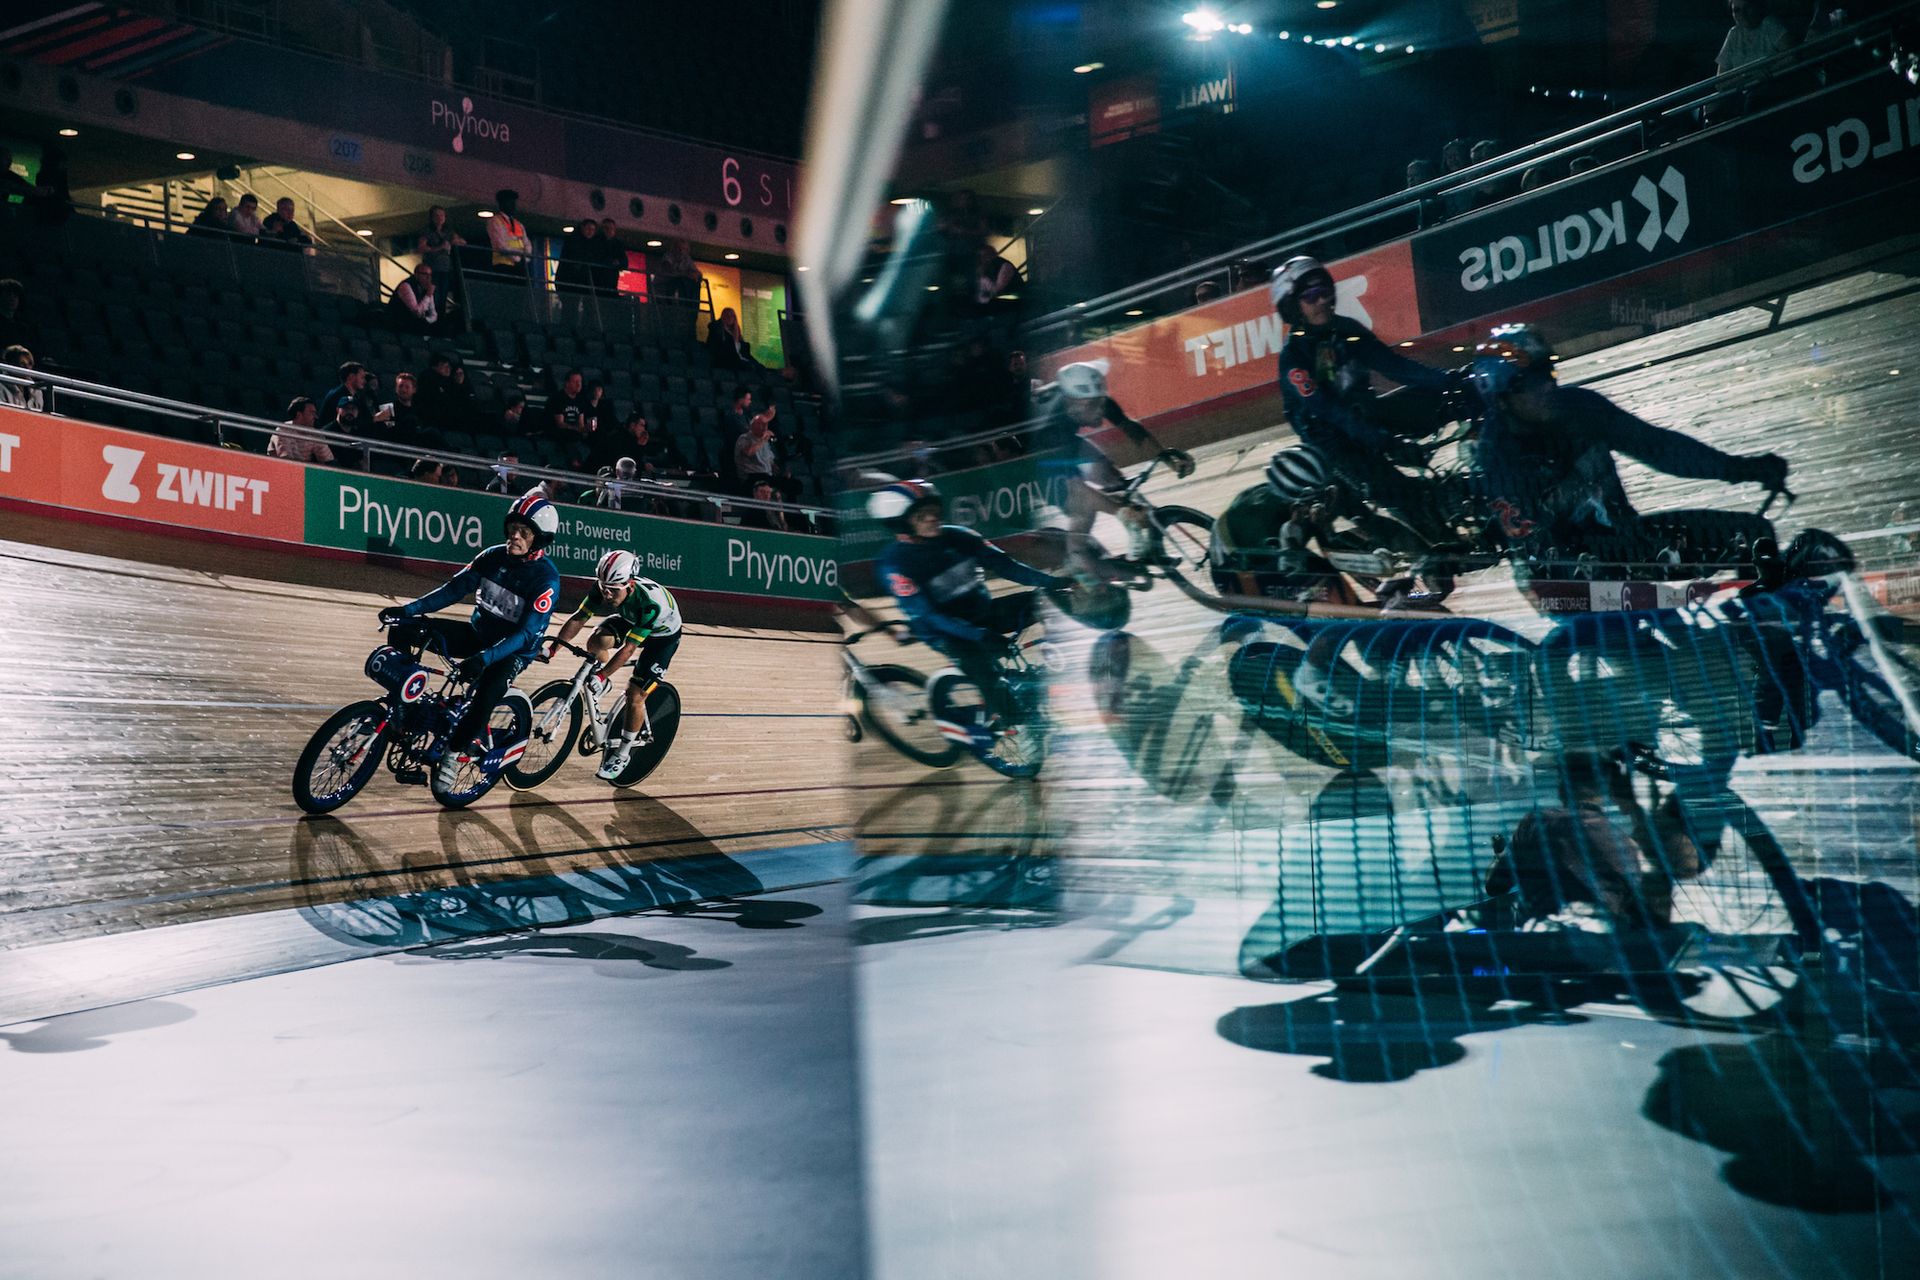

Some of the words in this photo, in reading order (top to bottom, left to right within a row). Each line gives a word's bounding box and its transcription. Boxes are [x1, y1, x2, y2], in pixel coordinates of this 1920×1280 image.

[431, 97, 510, 153] Phynova
[335, 138, 358, 160] 207
[722, 156, 742, 206] 6
[156, 463, 270, 516] ZWIFT
[339, 484, 483, 548] Phynova
[575, 520, 631, 543] Powered
[573, 545, 598, 562] and
[647, 552, 683, 571] Relief
[728, 538, 838, 590] Phynova
[533, 587, 555, 614] 6
[371, 654, 388, 673] 6
